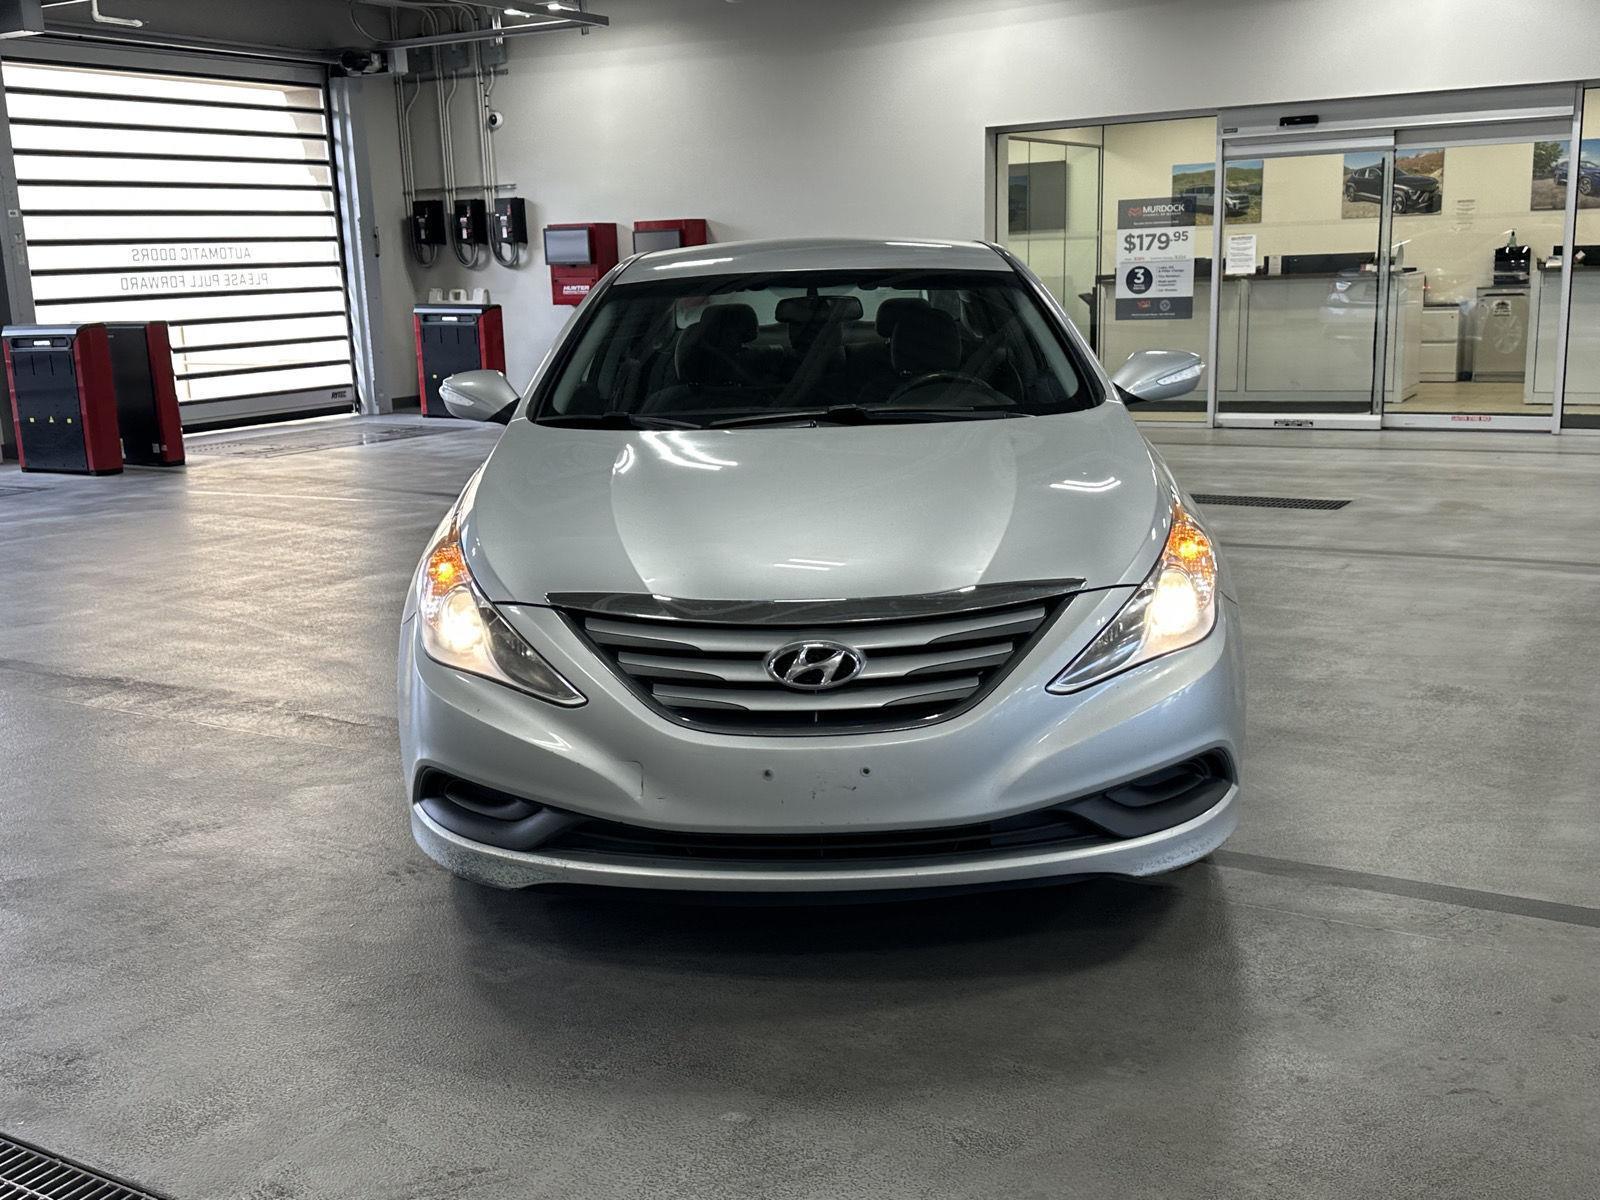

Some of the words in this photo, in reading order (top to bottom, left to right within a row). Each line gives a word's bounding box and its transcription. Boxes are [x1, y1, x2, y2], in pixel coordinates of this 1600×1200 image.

[1142, 204, 1185, 213] MURDOCK
[1123, 231, 1189, 254] $179.95
[1133, 268, 1145, 284] 3
